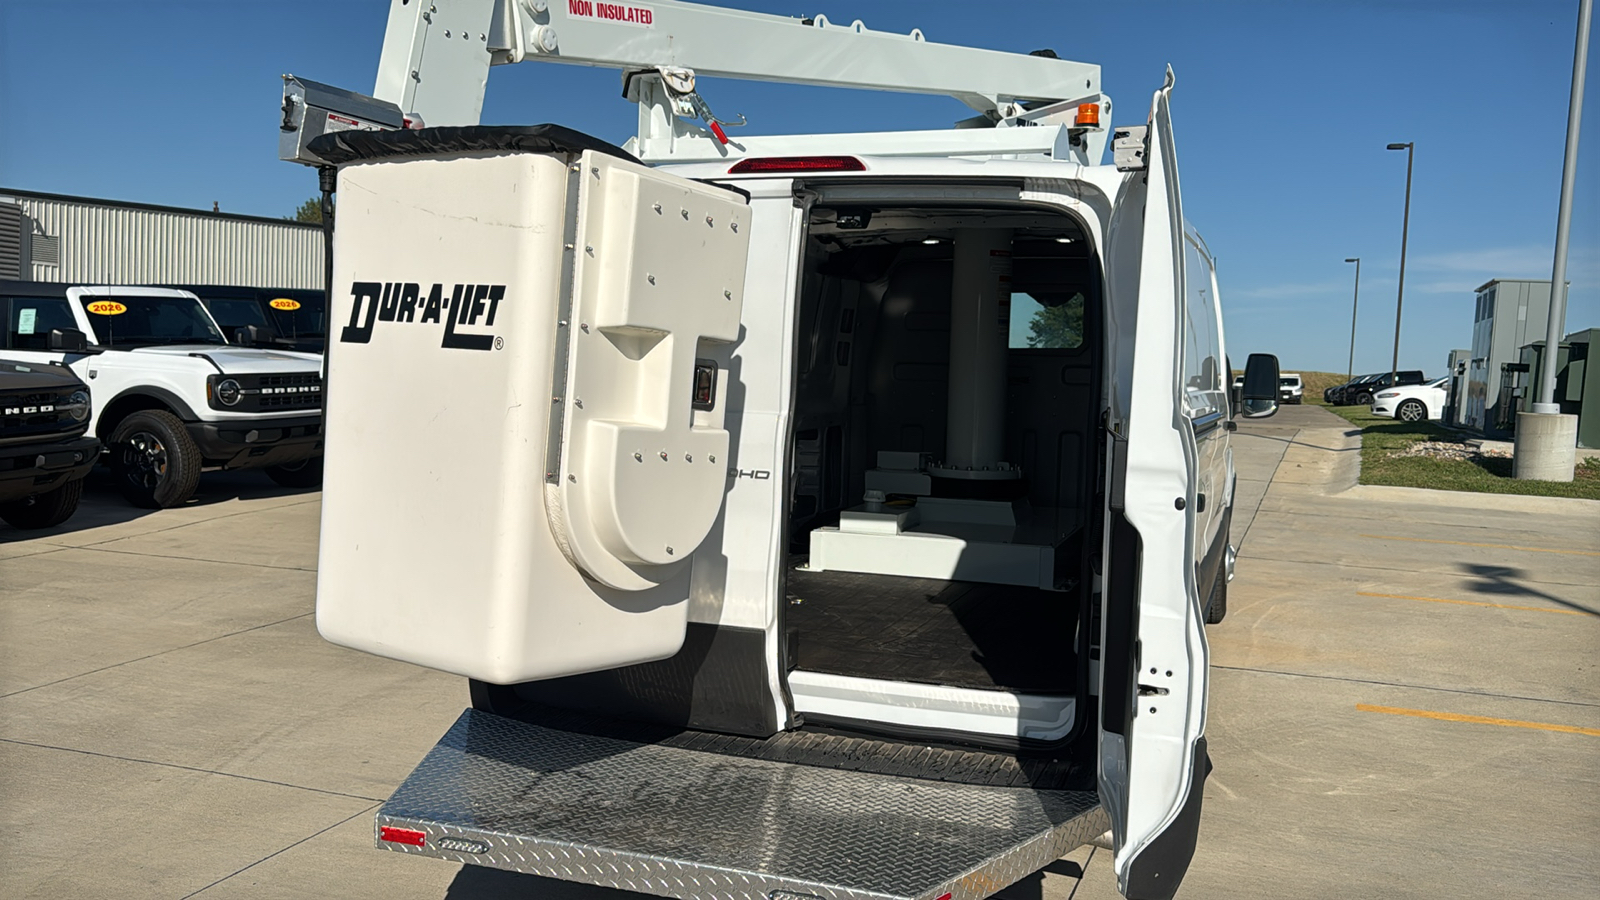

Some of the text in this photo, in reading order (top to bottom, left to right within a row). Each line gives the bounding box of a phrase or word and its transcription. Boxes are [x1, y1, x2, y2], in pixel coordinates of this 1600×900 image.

[568, 0, 653, 25] NON INSULATED
[92, 304, 122, 312] 2026
[261, 385, 320, 394] BRONC
[0, 405, 54, 415] NCO
